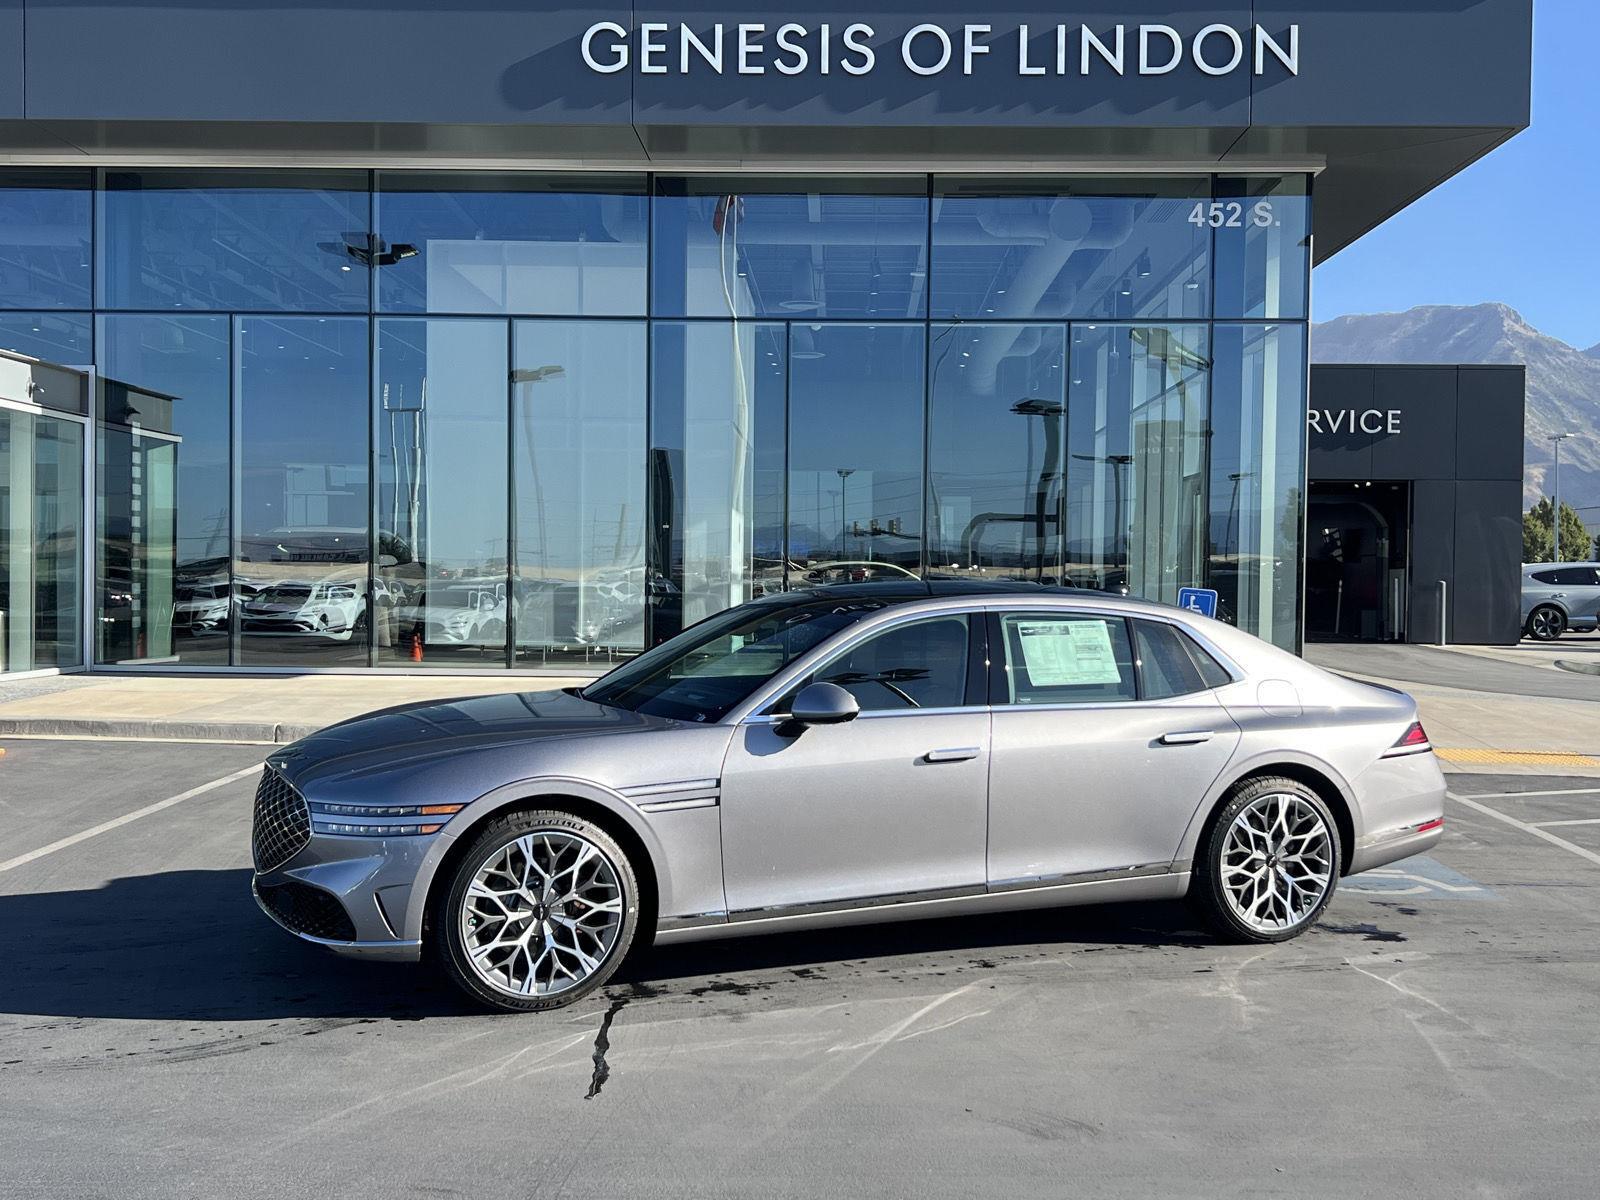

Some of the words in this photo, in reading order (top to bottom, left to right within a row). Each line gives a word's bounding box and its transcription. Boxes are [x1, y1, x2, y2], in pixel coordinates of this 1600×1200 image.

[580, 21, 876, 76] GENESIS
[901, 23, 992, 76] OF
[1018, 23, 1299, 76] LINDON
[1187, 201, 1243, 228] 452
[1253, 201, 1281, 228] S.
